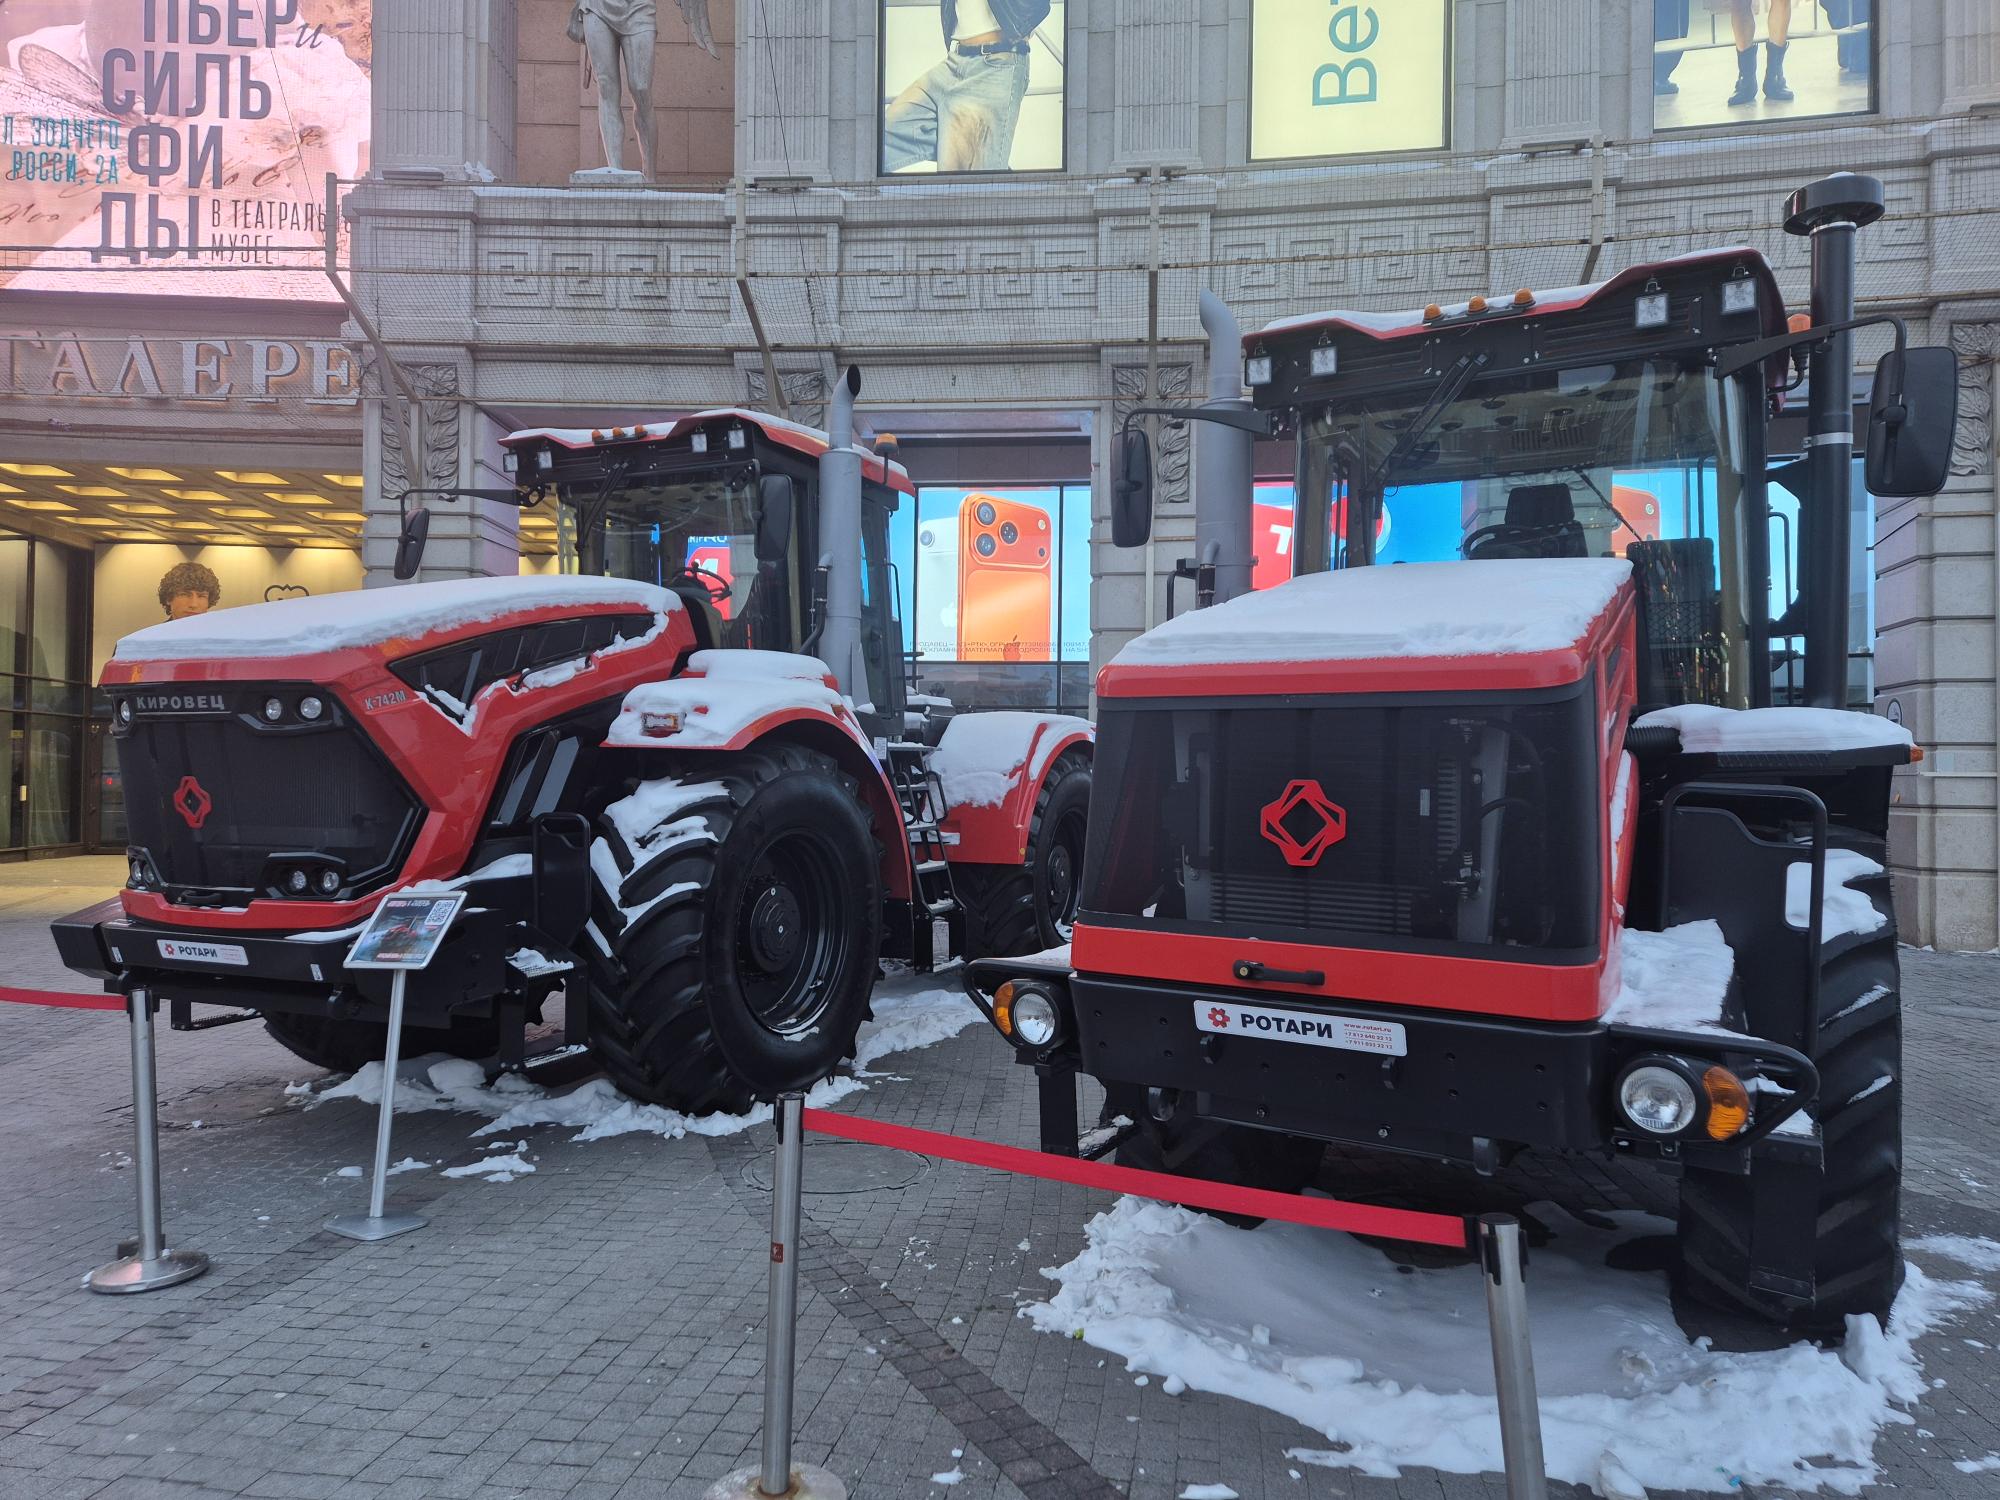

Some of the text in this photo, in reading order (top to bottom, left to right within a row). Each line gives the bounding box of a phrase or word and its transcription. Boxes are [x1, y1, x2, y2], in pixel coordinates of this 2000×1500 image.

[102, 48, 272, 120] СИЛЬ
[31, 116, 120, 150] ЗОДЧЕГО
[13, 151, 119, 185] РОССИ, 2А
[127, 122, 223, 190] ФИ
[91, 192, 200, 264] ДЫ
[211, 198, 221, 228] В
[211, 233, 274, 264] МУЗЕЕ
[136, 695, 225, 713] КИРОВЕЦ
[364, 690, 407, 711] К-742М
[177, 945, 218, 958] РОТАРИ
[1240, 1013, 1334, 1039] РОТАРИ
